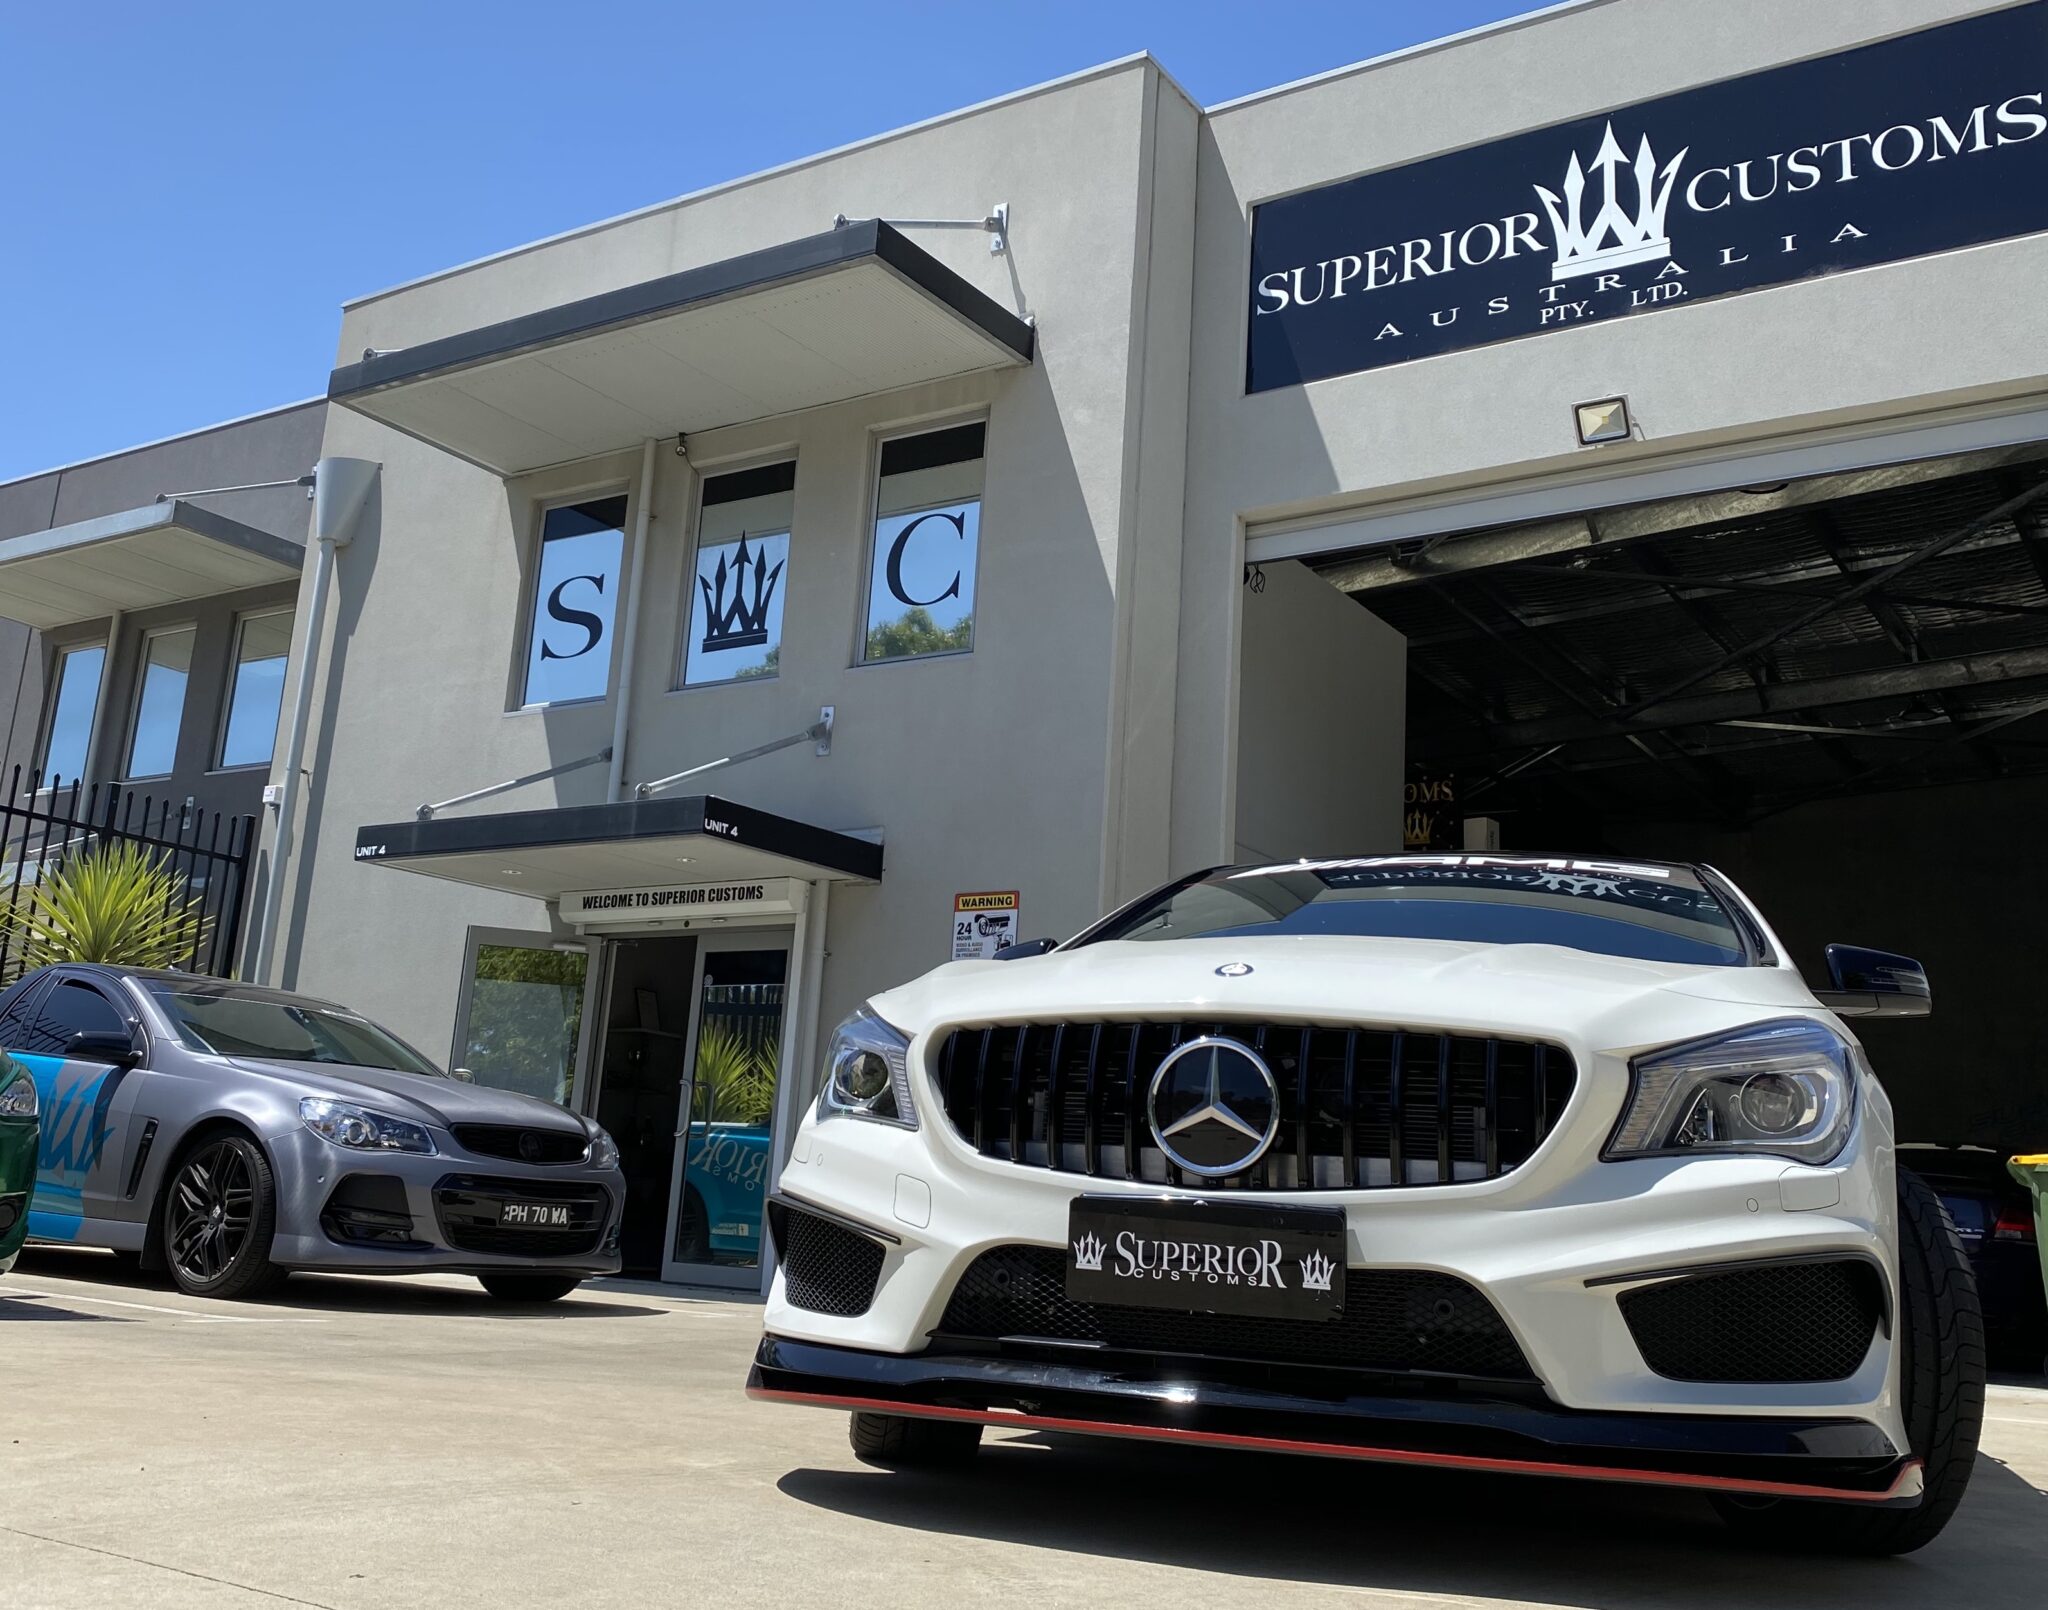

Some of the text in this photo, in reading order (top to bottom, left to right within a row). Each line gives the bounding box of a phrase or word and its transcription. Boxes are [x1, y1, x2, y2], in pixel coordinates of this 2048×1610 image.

[1256, 92, 2047, 316] SUPERIOR CUSTOMS
[1373, 222, 1869, 342] AUSTRALIA
[1540, 281, 1689, 325] PTY. LTD.
[886, 511, 965, 606] C
[541, 573, 605, 661] S
[704, 817, 739, 837] UNIT 4
[356, 844, 386, 857] UNIT 4
[582, 885, 764, 910] WELCOME TO SUPERIOR CUSTOMS
[961, 896, 1013, 908] WARNING
[957, 922, 972, 935] 24
[508, 1205, 567, 1224] PH 70 WA
[1114, 1231, 1287, 1288] SUPERIOR
[1133, 1270, 1257, 1287] CUSTOMS
